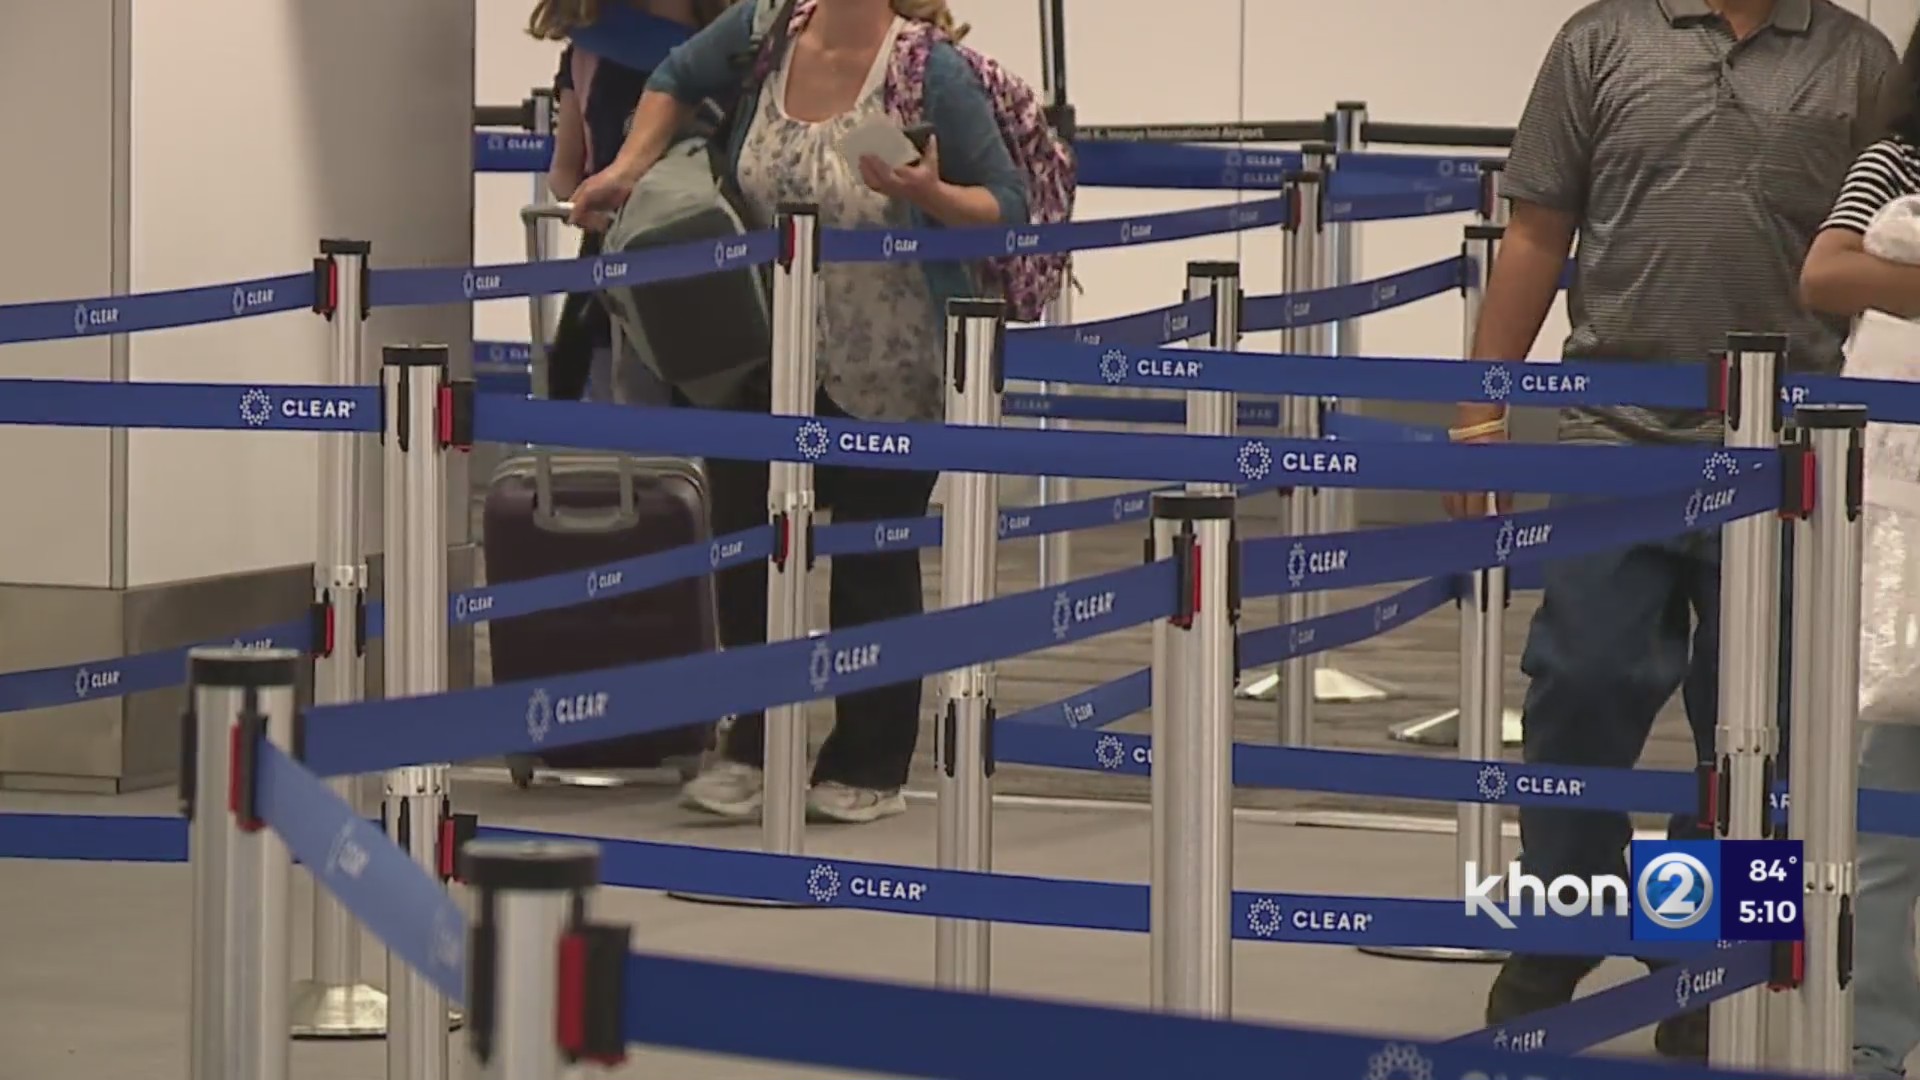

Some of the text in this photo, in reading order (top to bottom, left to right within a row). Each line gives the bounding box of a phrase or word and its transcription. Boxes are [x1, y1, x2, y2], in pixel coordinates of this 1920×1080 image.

[1222, 126, 1265, 139] Airport
[507, 138, 543, 150] CLEAR
[1245, 155, 1281, 166] CLEAR
[1459, 163, 1479, 174] CLE
[894, 238, 917, 252] CLEAR
[1017, 234, 1039, 247] CLEAR
[726, 244, 748, 260] CLEAR
[605, 263, 628, 277] CLEAR
[476, 275, 500, 290] CLEAR
[247, 288, 273, 305] CLEAR
[90, 308, 118, 325] CLEAR
[1138, 360, 1199, 378] CLEAR
[1522, 374, 1584, 393] CLEAR
[282, 399, 351, 419] CLEAR
[839, 432, 911, 454] CLEAR
[1282, 452, 1358, 473] CLEAR
[1124, 500, 1144, 513] CLEAR
[1703, 490, 1734, 513] CLEAR
[1009, 516, 1030, 530] CLEAR
[887, 527, 910, 542] CLEAR
[1515, 526, 1551, 547] CLEAR
[720, 542, 742, 558] CLEAR
[1309, 551, 1346, 575] CLEAR
[599, 572, 623, 589] CLEAR
[469, 596, 493, 612] CLEAR
[1074, 593, 1113, 623] CLEAR
[834, 645, 877, 673] CLEAR
[91, 671, 119, 689] CLEAR
[555, 694, 606, 724] CLEAR
[1516, 776, 1582, 796] CLEAR
[850, 878, 923, 900] CLEAR
[1292, 911, 1367, 931] CLEAR
[1692, 967, 1725, 993] CLEAR
